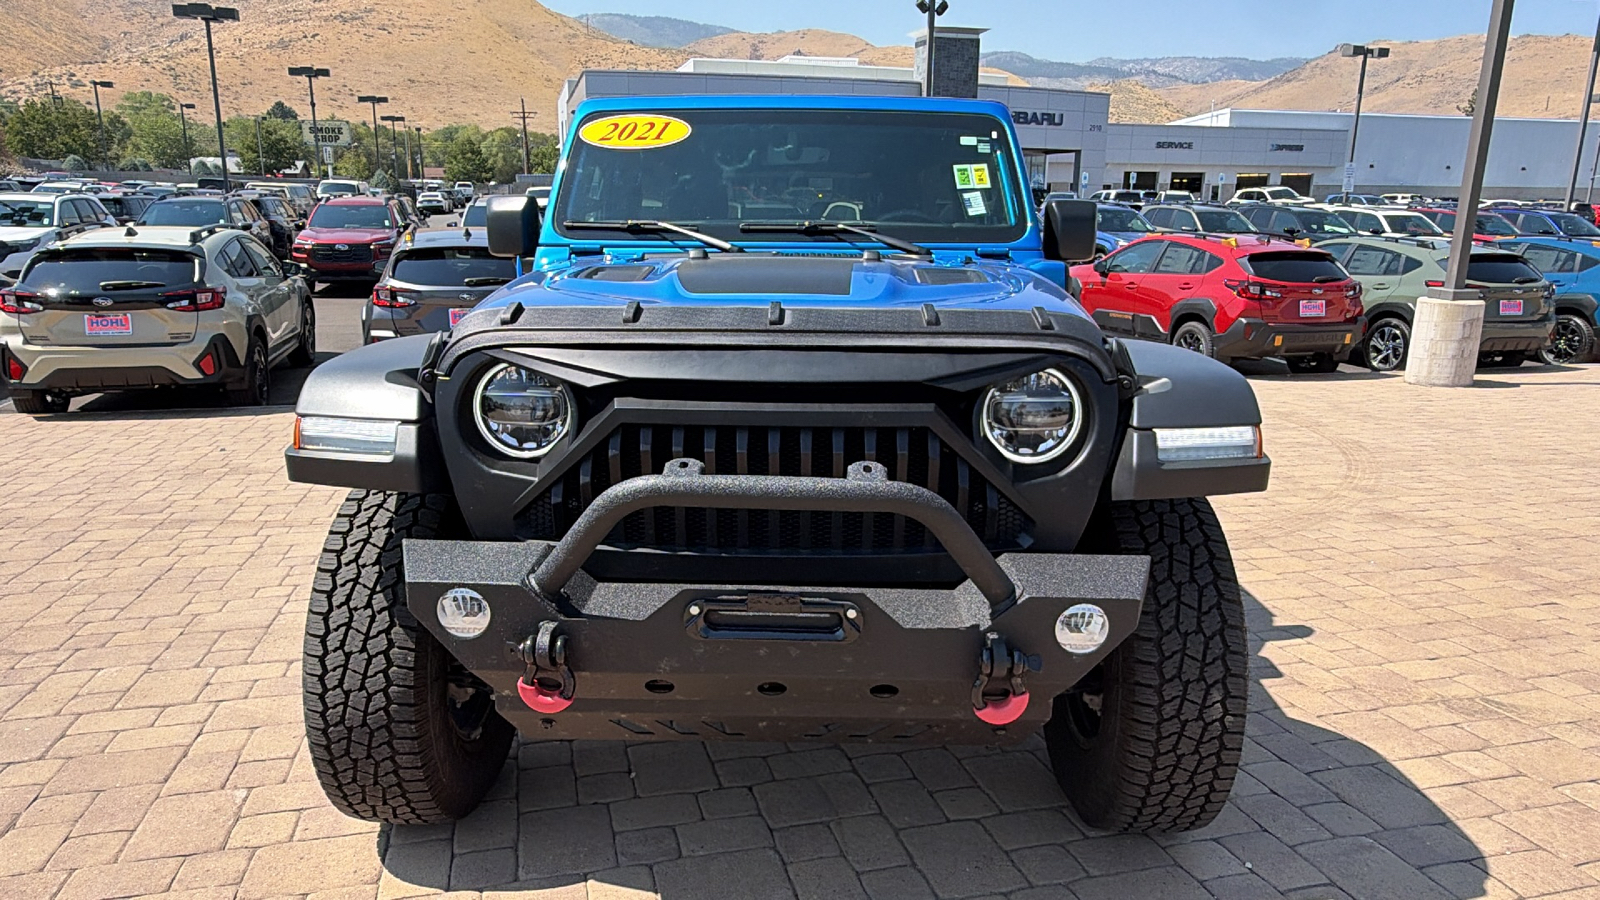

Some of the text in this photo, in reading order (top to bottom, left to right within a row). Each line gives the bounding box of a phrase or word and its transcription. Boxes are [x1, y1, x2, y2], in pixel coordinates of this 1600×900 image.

[1012, 111, 1064, 126] BARU
[309, 126, 344, 135] SMOKE
[598, 121, 672, 141] 2021
[313, 134, 341, 143] SHOP
[1155, 141, 1194, 150] SERVICE
[90, 318, 127, 327] HOHL
